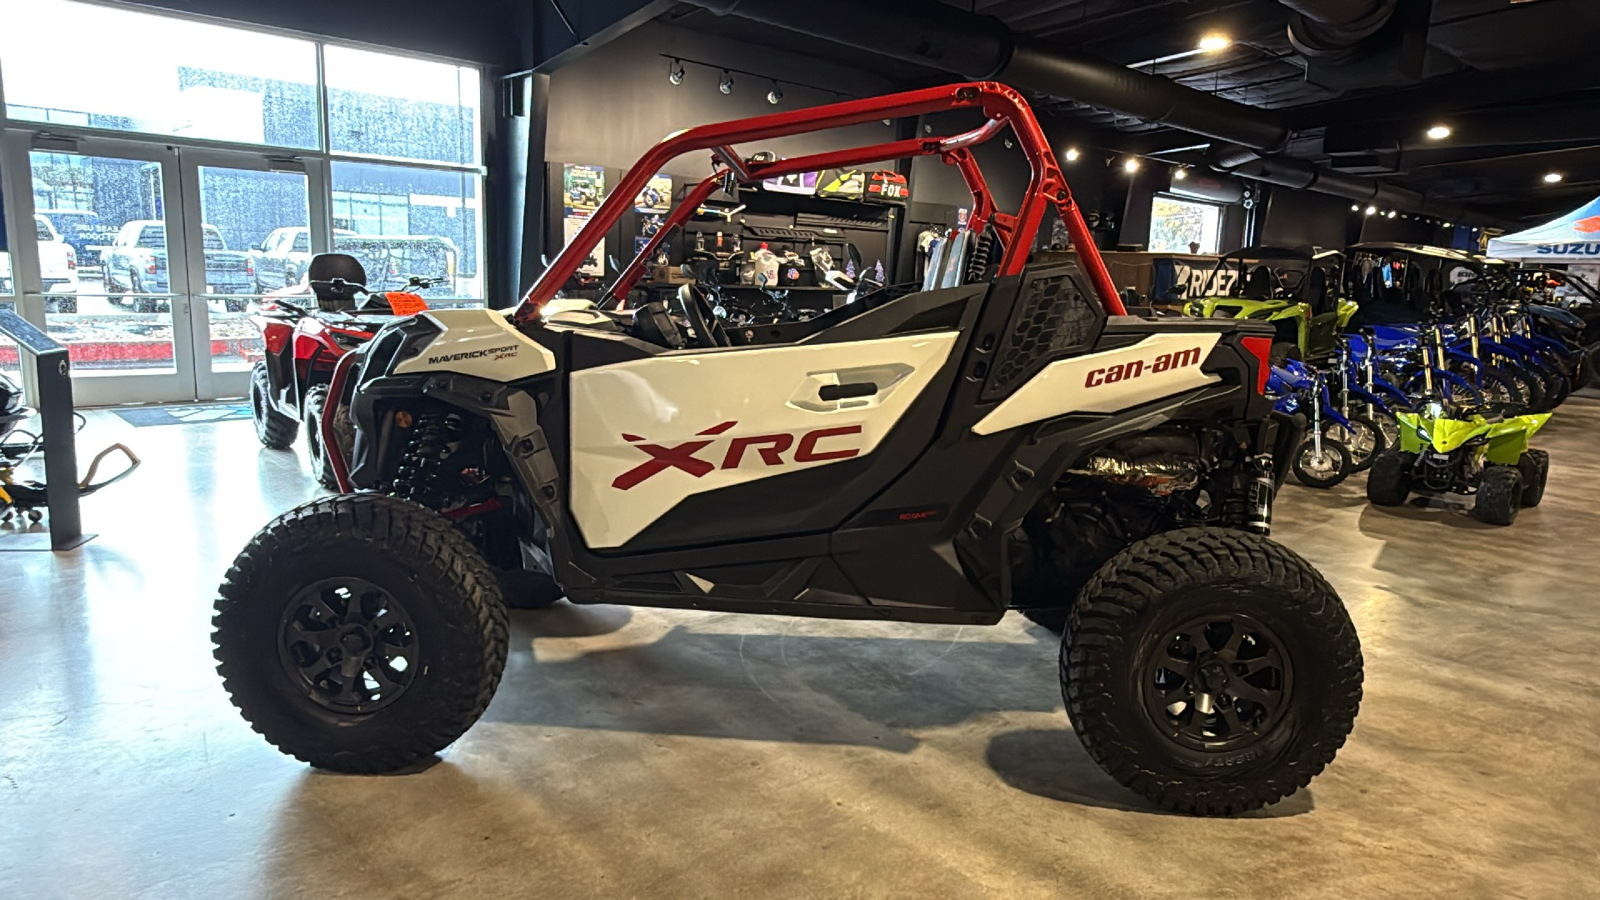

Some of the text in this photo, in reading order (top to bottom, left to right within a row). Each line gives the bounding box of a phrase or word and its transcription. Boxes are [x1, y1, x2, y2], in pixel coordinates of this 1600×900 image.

[881, 183, 901, 198] FOX
[428, 345, 519, 364] MAVERICK SPORT
[494, 352, 518, 361] XRC
[1085, 346, 1201, 388] can-am
[611, 420, 862, 491] XRC
